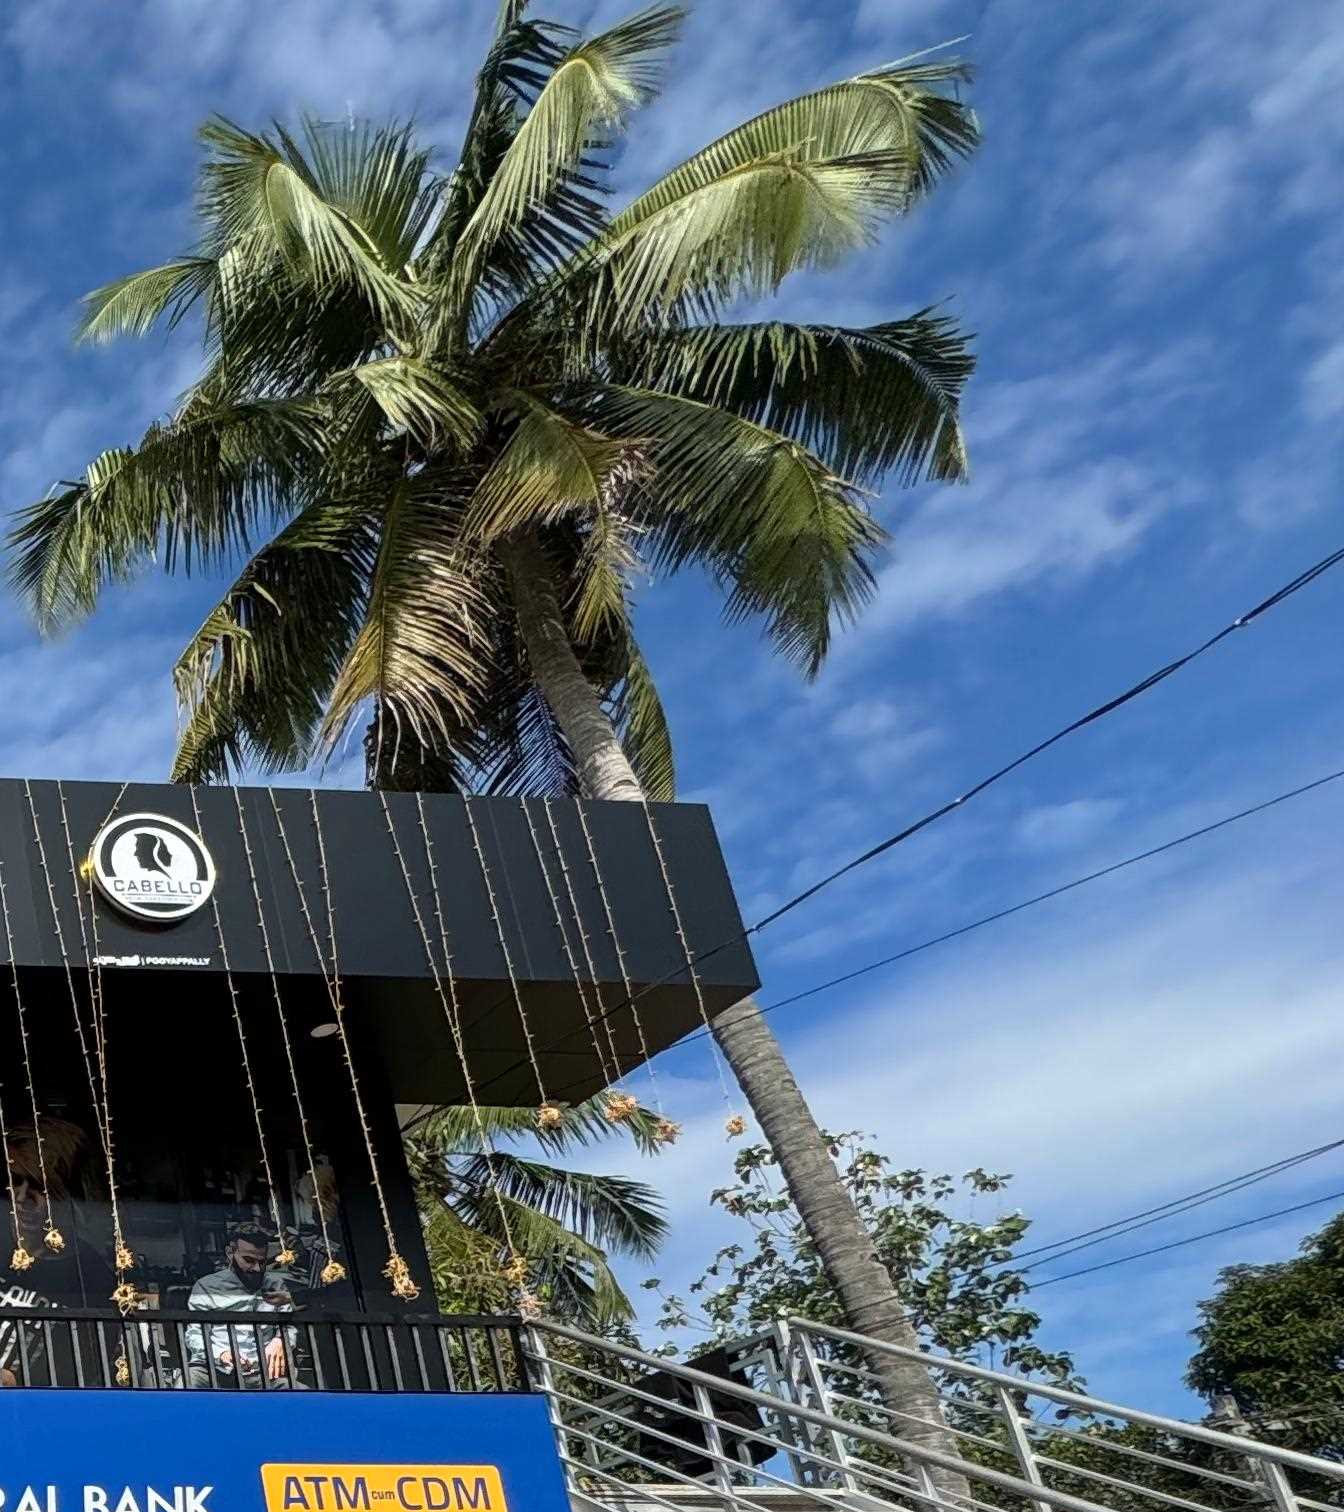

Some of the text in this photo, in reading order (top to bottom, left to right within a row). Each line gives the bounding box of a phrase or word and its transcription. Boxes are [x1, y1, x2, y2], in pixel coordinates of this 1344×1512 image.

[113, 879, 203, 895] CABELLO
[282, 1475, 492, 1511] ATM cum CDM
